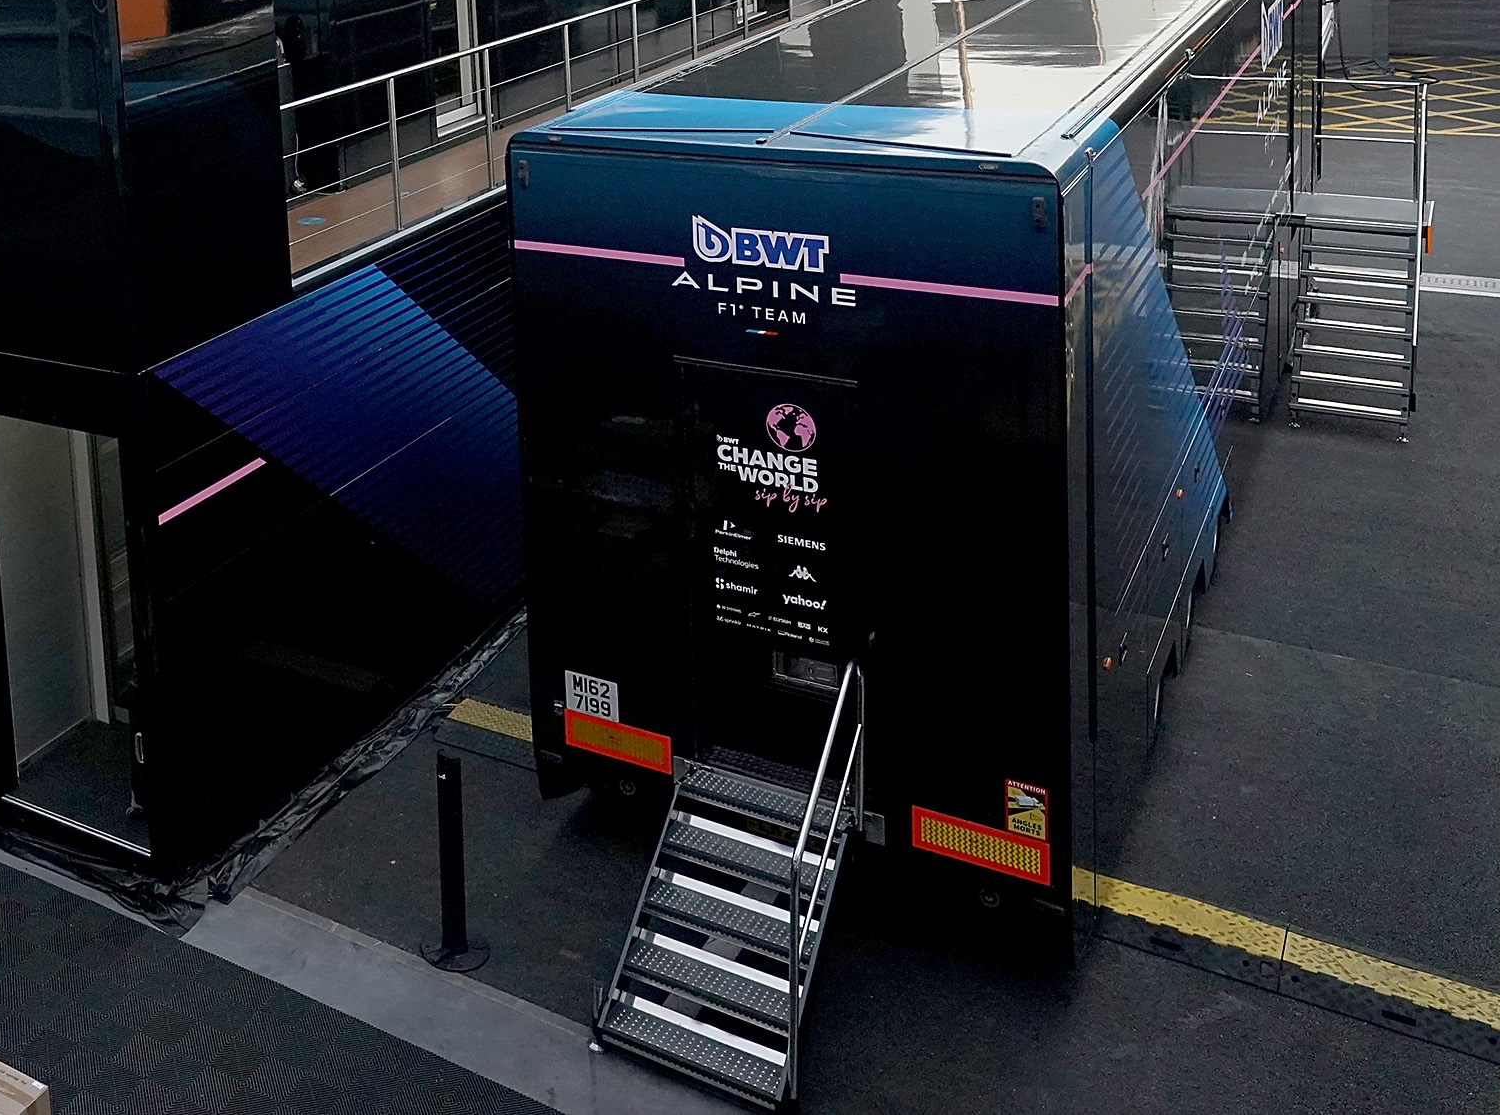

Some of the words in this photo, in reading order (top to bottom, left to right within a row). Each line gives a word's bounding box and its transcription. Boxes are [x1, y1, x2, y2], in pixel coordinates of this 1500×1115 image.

[730, 227, 830, 273] BWT
[671, 270, 857, 307] ALPINE
[751, 306, 807, 325] TEAM
[717, 444, 818, 477] CHANGE
[718, 462, 737, 472] THE
[737, 465, 819, 493] WORLD
[754, 488, 778, 508] sip
[782, 483, 800, 513] by
[804, 493, 828, 513] sip
[713, 546, 738, 558] Delphi
[777, 534, 827, 552] SIEMENS
[714, 553, 760, 570] Technologies
[725, 581, 759, 596] shamir
[782, 593, 828, 611] yahoo!
[1007, 779, 1047, 796] ATTENTION
[1011, 816, 1043, 832] ANGLES
[1013, 823, 1041, 837] MORTS
